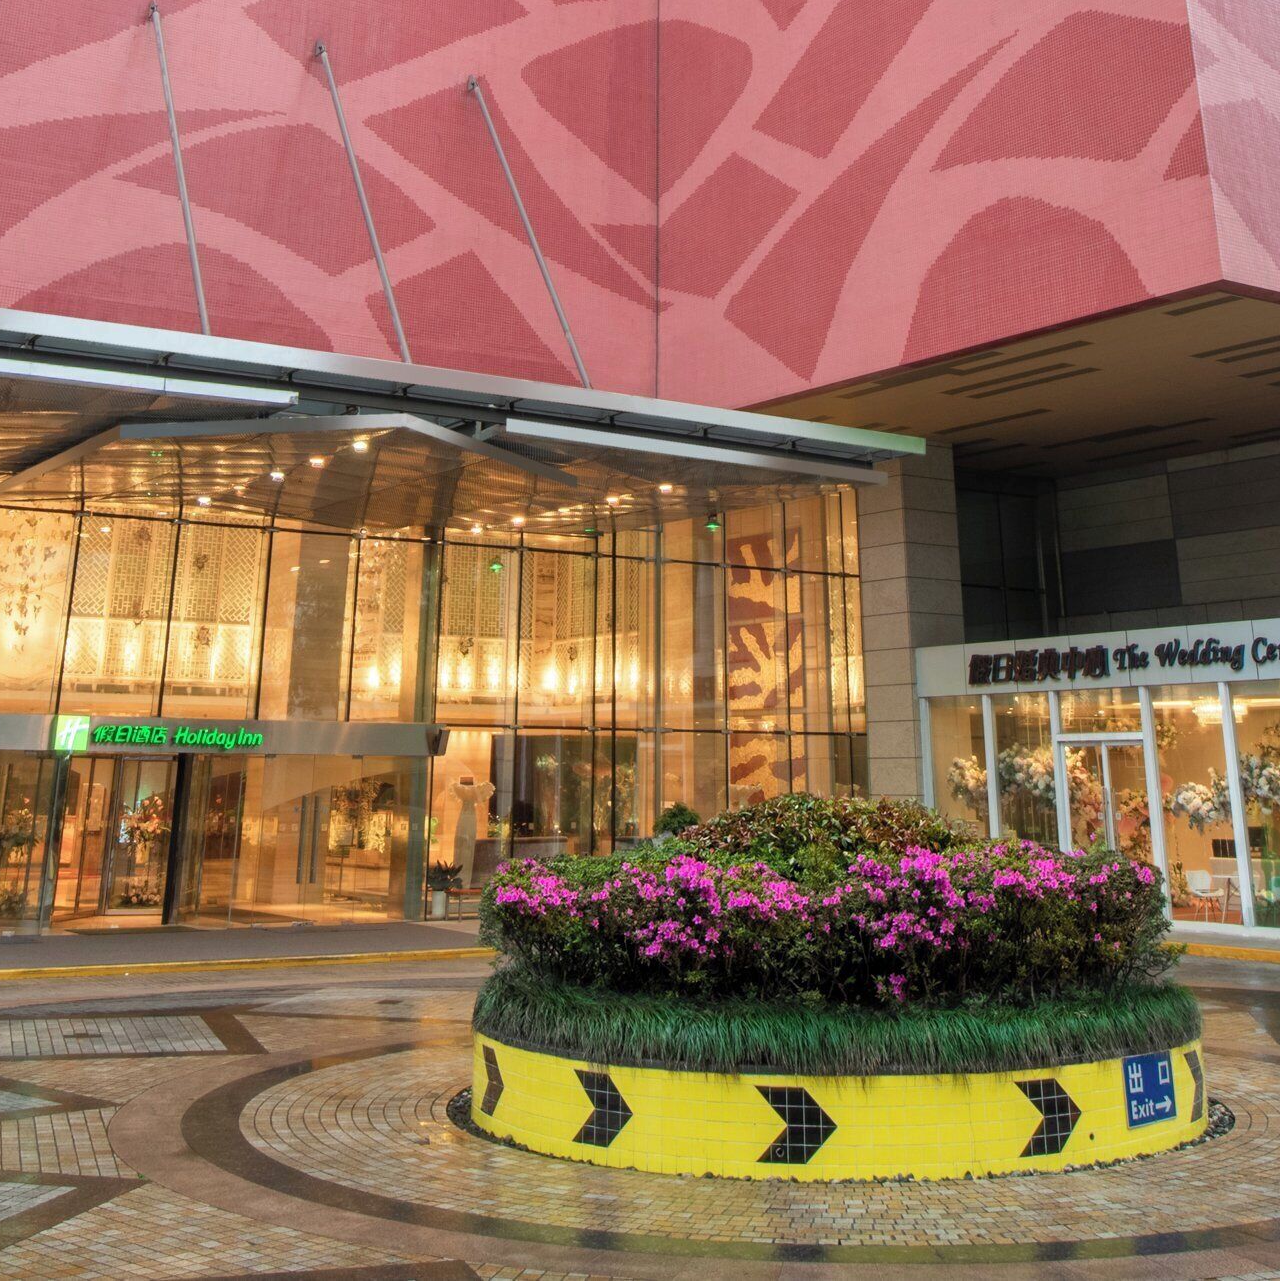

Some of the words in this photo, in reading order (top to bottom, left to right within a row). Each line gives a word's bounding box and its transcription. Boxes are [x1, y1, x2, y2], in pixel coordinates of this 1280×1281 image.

[1113, 643, 1149, 670] The
[1154, 638, 1245, 671] Wedding
[93, 724, 168, 745] 假日酒店
[174, 726, 236, 750] Holiday
[237, 727, 263, 746] Inn
[1128, 1060, 1170, 1093] 出口
[1130, 1098, 1155, 1120] Exit
